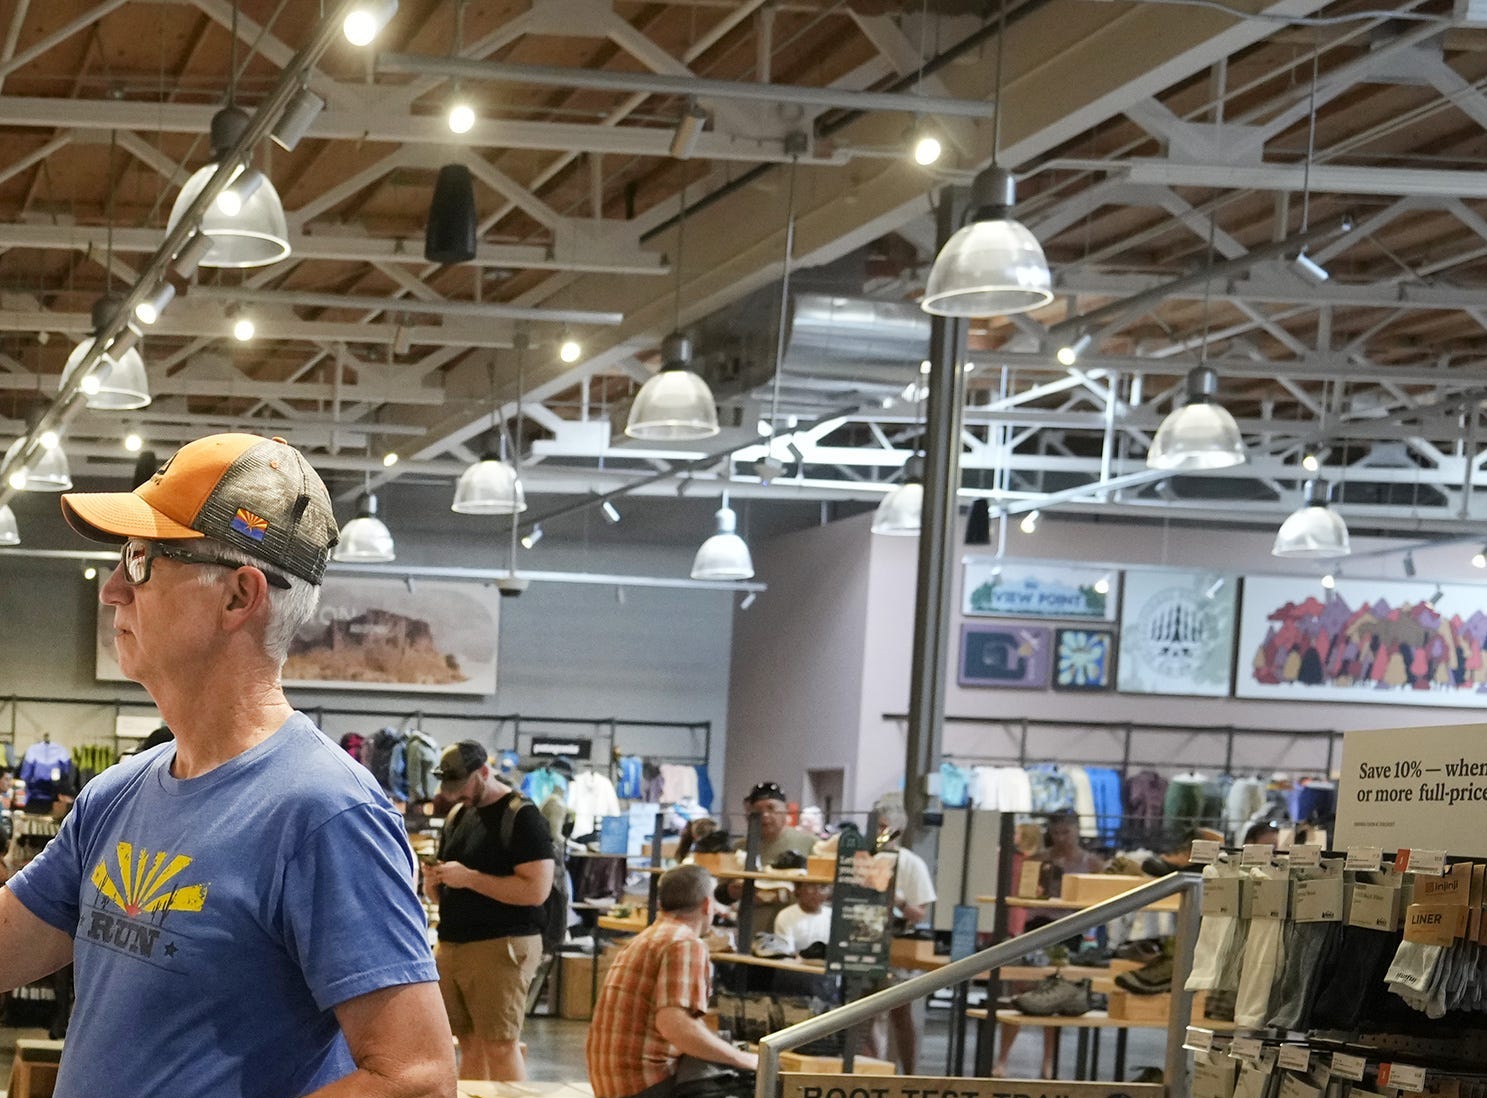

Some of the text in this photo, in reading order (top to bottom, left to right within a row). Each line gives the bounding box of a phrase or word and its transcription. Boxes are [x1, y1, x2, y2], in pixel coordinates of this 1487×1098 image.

[1359, 762, 1391, 779] Save
[1393, 760, 1423, 778] 10%
[1445, 758, 1487, 777] when
[1357, 788, 1372, 802] or
[1375, 788, 1413, 802] more
[1434, 880, 1459, 893] injinji
[1411, 913, 1443, 925] LINER
[87, 911, 161, 959] RUN
